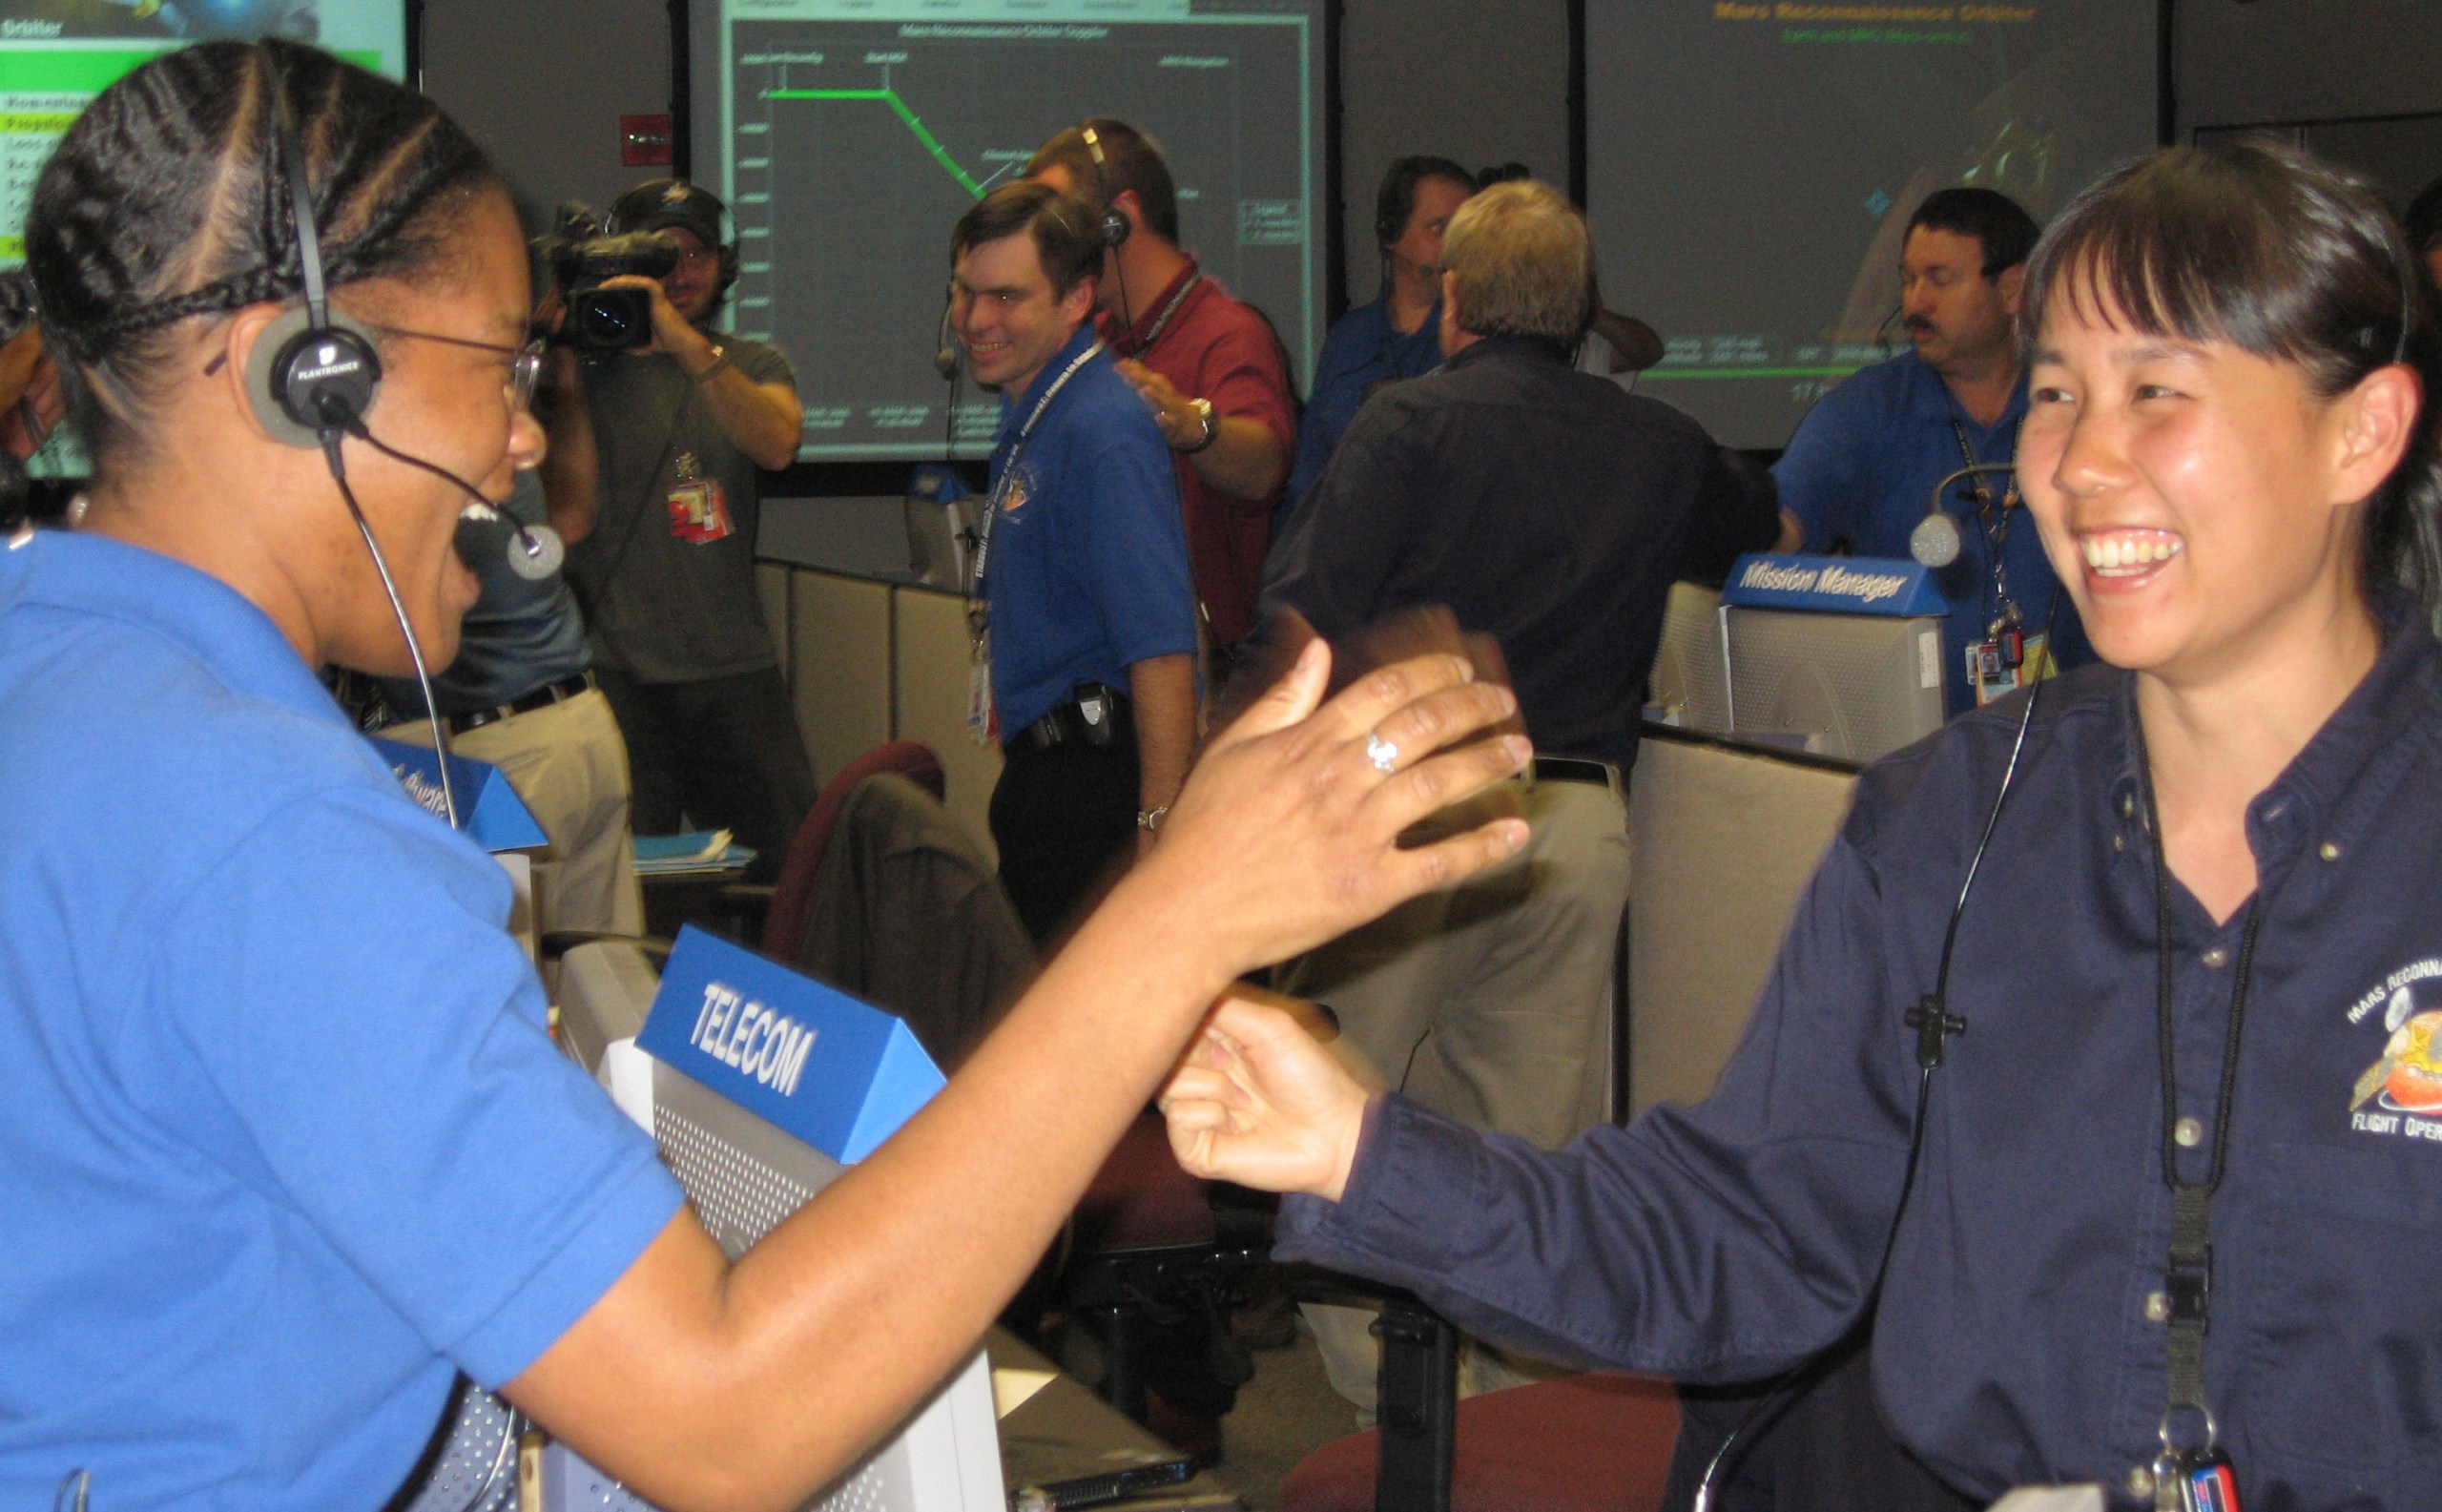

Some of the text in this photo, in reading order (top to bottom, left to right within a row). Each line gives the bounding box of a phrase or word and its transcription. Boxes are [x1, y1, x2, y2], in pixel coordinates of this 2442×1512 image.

[298, 362, 359, 381] PLANTRONICS
[1739, 561, 1907, 603] Mission Manager
[2348, 985, 2387, 1024] MARS
[690, 982, 817, 1098] TELECOM
[2351, 1110, 2400, 1134] FLIGHT
